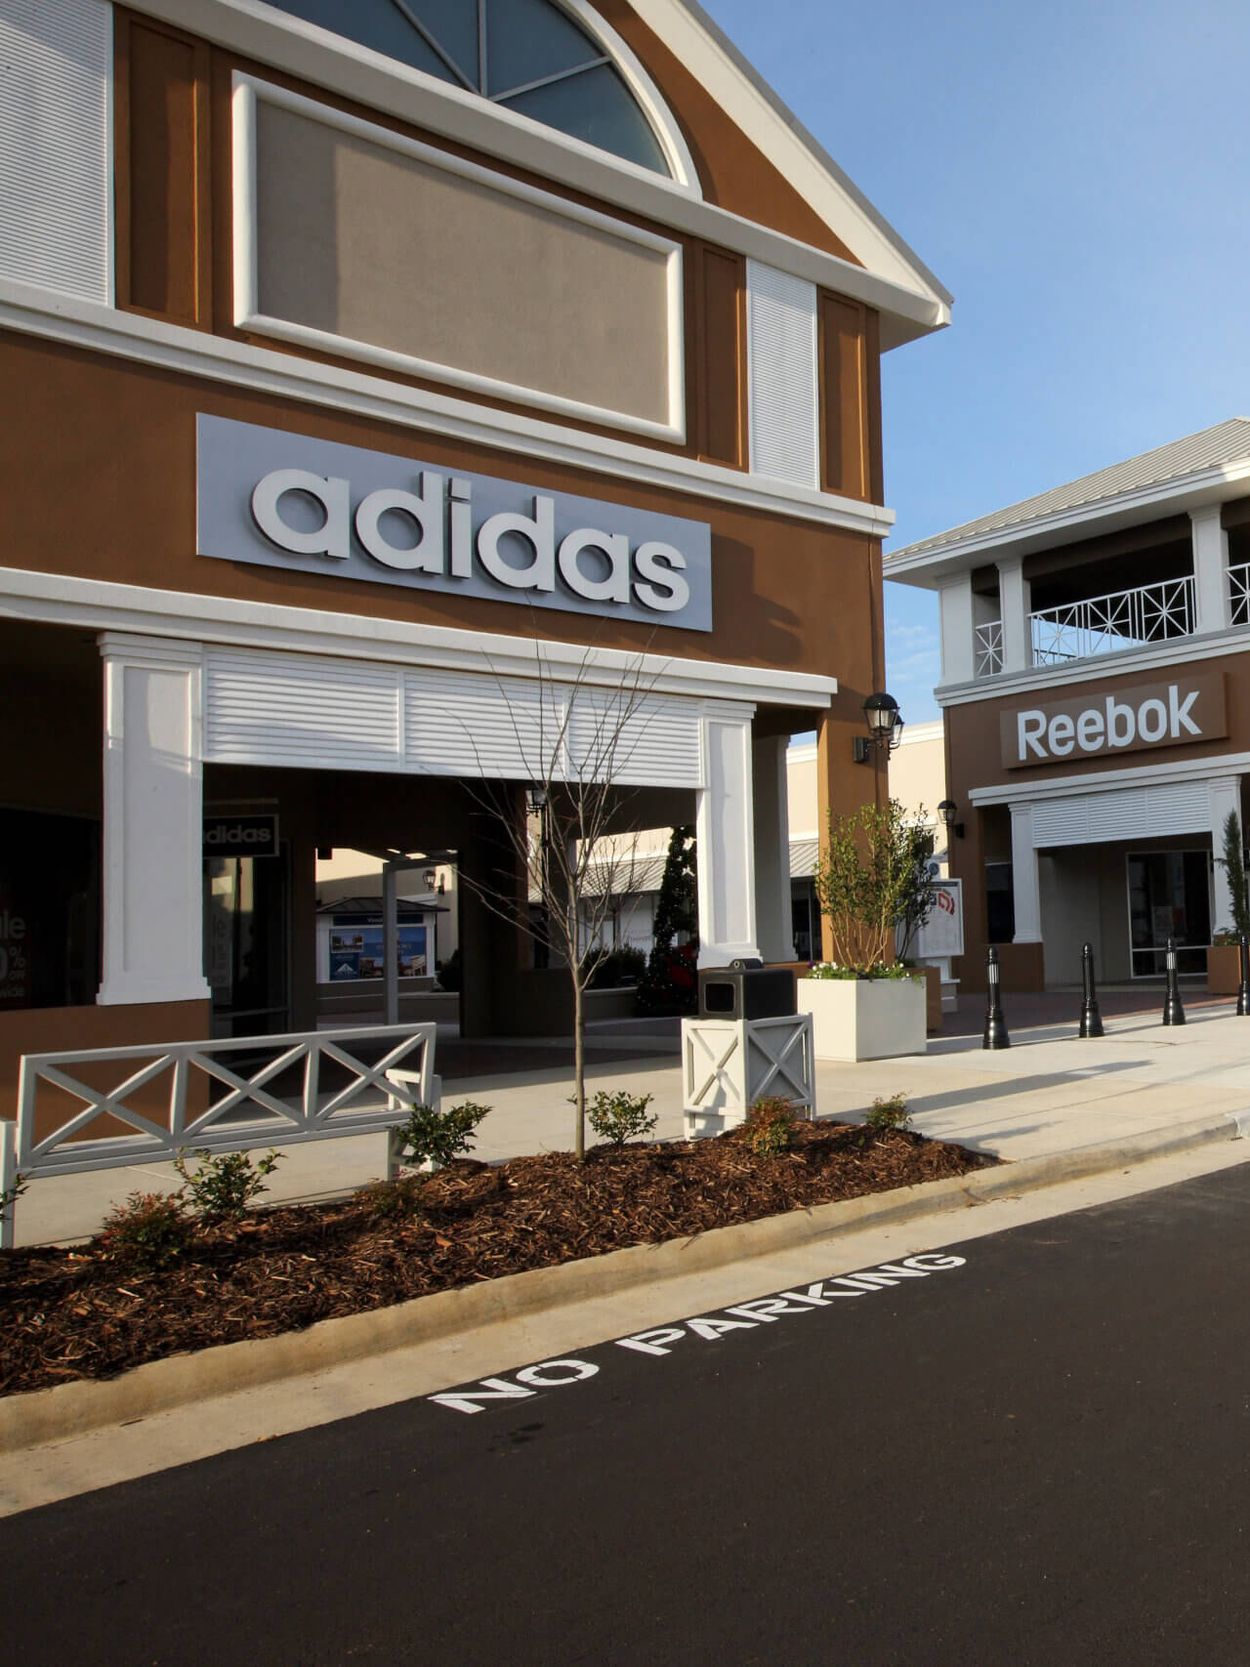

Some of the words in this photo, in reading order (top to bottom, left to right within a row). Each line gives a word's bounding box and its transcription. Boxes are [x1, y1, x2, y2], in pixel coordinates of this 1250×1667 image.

[251, 468, 691, 613] adidas
[1017, 685, 1202, 761] Reebok
[203, 824, 272, 845] didas
[0, 909, 26, 940] le
[427, 1359, 600, 1414] NO
[615, 1253, 967, 1357] PARKING
